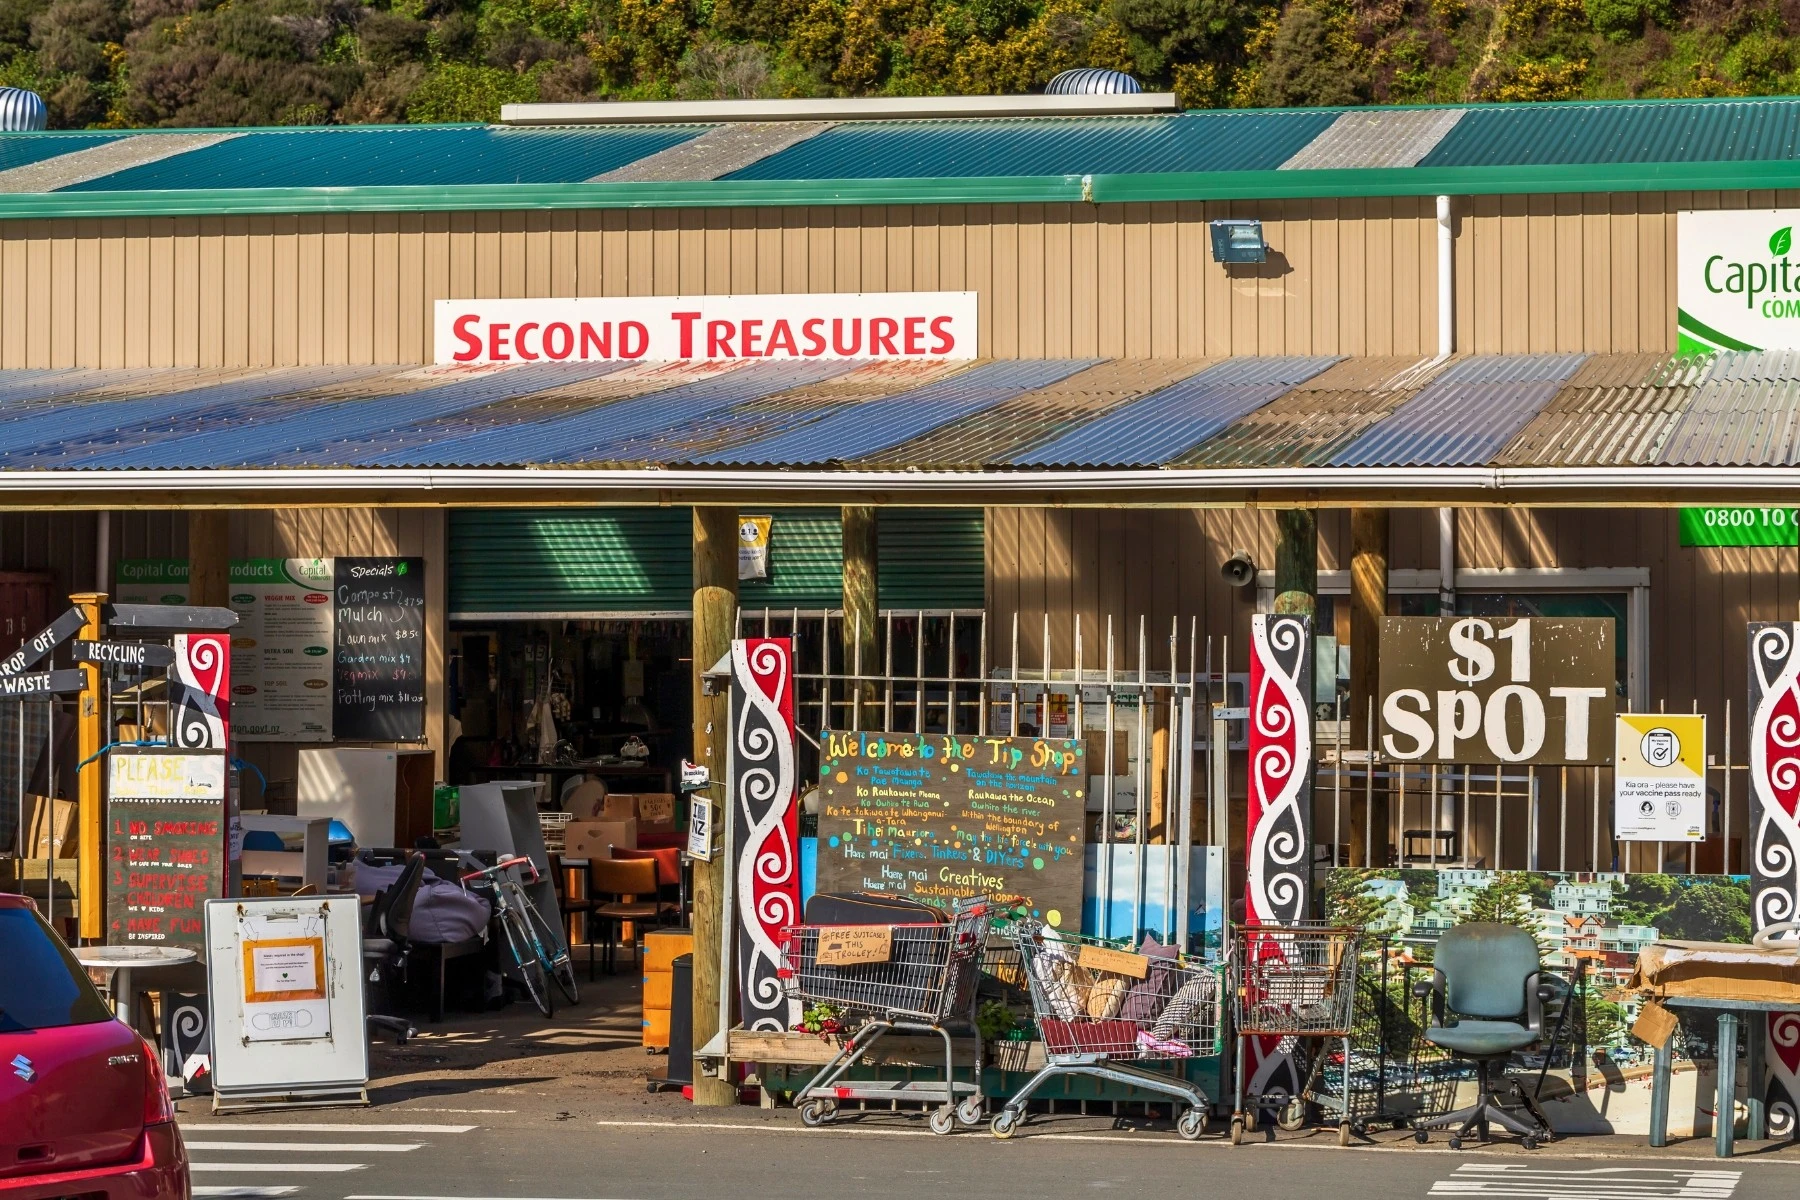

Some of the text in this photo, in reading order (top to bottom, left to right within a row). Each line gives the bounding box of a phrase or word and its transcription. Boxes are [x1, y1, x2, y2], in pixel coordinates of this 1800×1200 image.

[452, 312, 955, 361] Second Treasures
[1704, 508, 1786, 527] 0800 TO
[123, 563, 273, 580] Capital Com roducts
[299, 565, 326, 578] Capital
[350, 564, 393, 579] Specials
[338, 585, 395, 605] Compost
[338, 606, 382, 623] Mulch
[0, 628, 56, 676] ROP OFF
[88, 642, 145, 663] RECYCLING
[338, 650, 376, 664] Garden
[379, 654, 396, 663] mix
[1447, 617, 1531, 687] $1
[379, 693, 394, 702] mix
[1382, 685, 1607, 762] SPOT
[829, 732, 914, 759] Welcome
[915, 735, 935, 759] to
[943, 736, 975, 760] the
[985, 739, 1023, 770] Tip
[1030, 740, 1076, 775] Shop
[116, 756, 186, 781] PLEASE
[856, 765, 869, 776] Ko
[870, 776, 887, 785] Pae
[989, 779, 1002, 788] the
[1655, 781, 1678, 791] please
[1678, 781, 1695, 789] have
[856, 785, 869, 797] Ko
[1619, 789, 1702, 799] your vaccine pass ready
[860, 798, 871, 807] Ko
[1008, 791, 1025, 802] the
[1026, 794, 1056, 808] Ocean
[826, 805, 838, 817] Ko
[1002, 804, 1019, 814] the
[129, 821, 147, 835] NO
[154, 821, 218, 836] SMOKING
[692, 821, 705, 836] NZ
[987, 812, 1002, 823] the
[1003, 815, 1044, 836] boundary
[1047, 820, 1060, 832] of
[113, 847, 123, 861] 2
[128, 848, 161, 862] WEAR
[869, 849, 888, 860] mai
[931, 845, 968, 861] Tinkers
[972, 846, 982, 862] &
[986, 849, 1025, 869] DIYers
[128, 872, 209, 893] SUPERVISE
[908, 868, 928, 881] mai
[939, 866, 1004, 890] Creatives
[888, 880, 907, 891] mai
[914, 881, 975, 898] Sustainable
[127, 891, 195, 909] CHILDREN
[127, 917, 161, 933] HAVE
[169, 917, 202, 934] FUN
[830, 931, 851, 940] FREE
[845, 941, 864, 949] THIS
[108, 1054, 139, 1066] SWIFT
